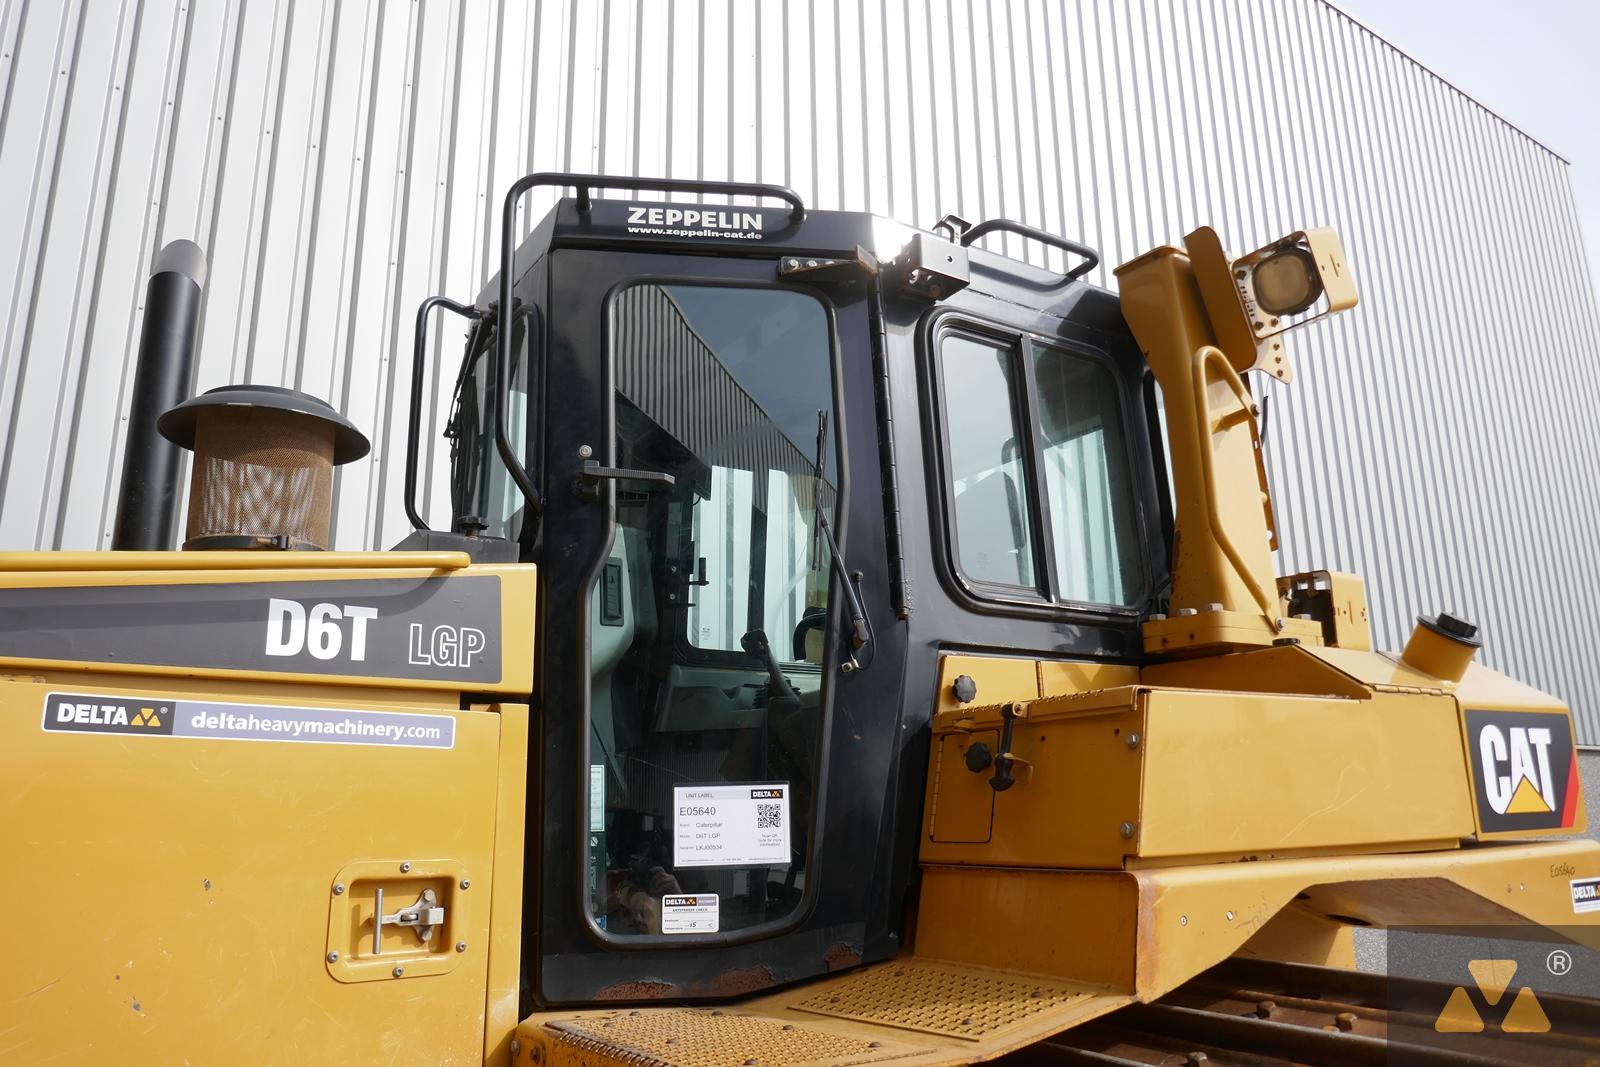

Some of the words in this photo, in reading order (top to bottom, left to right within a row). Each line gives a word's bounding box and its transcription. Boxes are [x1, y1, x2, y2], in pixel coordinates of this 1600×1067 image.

[627, 207, 763, 230] ZEPPELIN
[627, 226, 763, 240] www.zeppelin-cat.de
[265, 598, 378, 661] D6T
[408, 623, 485, 668] LGP
[56, 703, 129, 726] DELTA
[191, 711, 441, 740] deltaheavymachinery.com
[1479, 724, 1556, 815] CAT
[679, 806, 717, 816] E05640
[1550, 862, 1576, 879] E05640
[1573, 885, 1596, 899] DELTA
